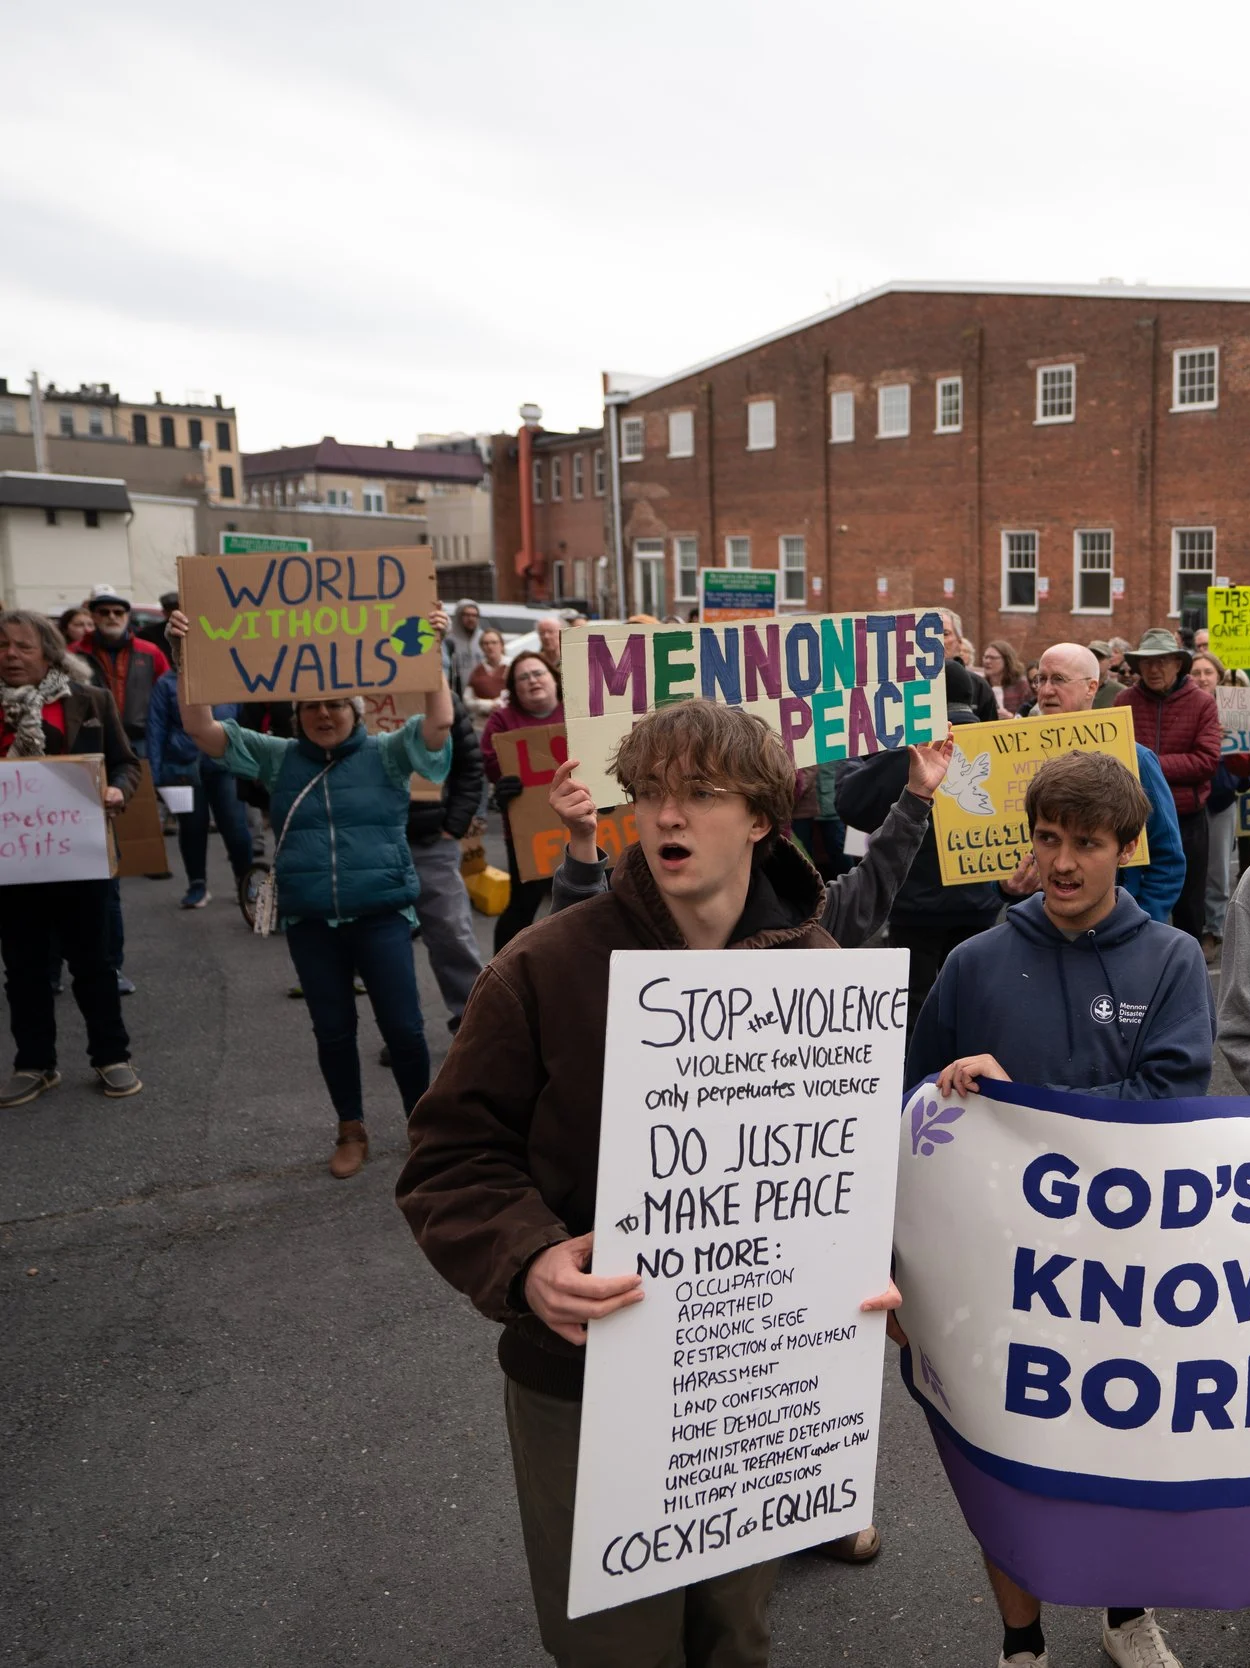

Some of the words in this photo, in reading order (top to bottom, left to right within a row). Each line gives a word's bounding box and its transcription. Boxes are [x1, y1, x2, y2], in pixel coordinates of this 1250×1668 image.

[217, 555, 406, 608] WORLD
[200, 603, 396, 641] WITHOUT
[1212, 623, 1243, 637] CAME
[230, 639, 398, 693] WALLS
[587, 612, 945, 717] MENNONITES
[1219, 688, 1247, 709] WE
[779, 680, 933, 768] PEACE
[992, 731, 1029, 754] WE
[1040, 722, 1118, 749] STAND
[1219, 710, 1250, 731] NOT
[959, 846, 1034, 875] RACI
[639, 977, 752, 1048] STOP
[747, 1010, 779, 1033] the
[772, 985, 909, 1038] VIOLENCE
[1118, 1016, 1142, 1024] Service
[1119, 1002, 1148, 1010] Mennon
[1119, 1009, 1145, 1017] Disaster
[676, 1051, 768, 1077] VIOLENCE
[798, 1044, 873, 1070] VIOLENCE
[697, 1079, 795, 1108] perpetuates
[803, 1077, 880, 1098] VIOLENCE
[651, 1124, 707, 1179] DO
[724, 1117, 857, 1172] JUSTICE
[644, 1182, 740, 1235] MAKE
[755, 1171, 854, 1223] PEACE
[637, 1248, 683, 1280] NO
[676, 1267, 795, 1302] OCCUPATION
[678, 1292, 773, 1323] APARTHEID
[676, 1318, 754, 1345] ECONOMIC
[761, 1308, 808, 1330] SIEGE
[673, 1338, 767, 1368] RESTRICTION
[770, 1335, 784, 1351] of
[787, 1325, 857, 1350] MOVEMENT
[673, 1361, 779, 1396] HARASSMENT
[673, 1398, 717, 1418] LAND
[722, 1376, 818, 1408] CONFISCATION
[672, 1419, 718, 1442] HOME
[723, 1401, 821, 1435] DEMOLITIONS
[665, 1462, 738, 1490] UNEQUAL
[810, 1440, 841, 1457] under
[844, 1429, 870, 1447] LAW
[668, 1431, 784, 1470] ADMINISTRATIVE
[789, 1412, 864, 1442] DETENTIONS
[663, 1482, 737, 1514] MILITARY
[741, 1463, 822, 1494] INCURSIONS
[601, 1507, 738, 1576] COEXIST
[737, 1517, 758, 1538] as
[762, 1478, 857, 1531] EQUALS
